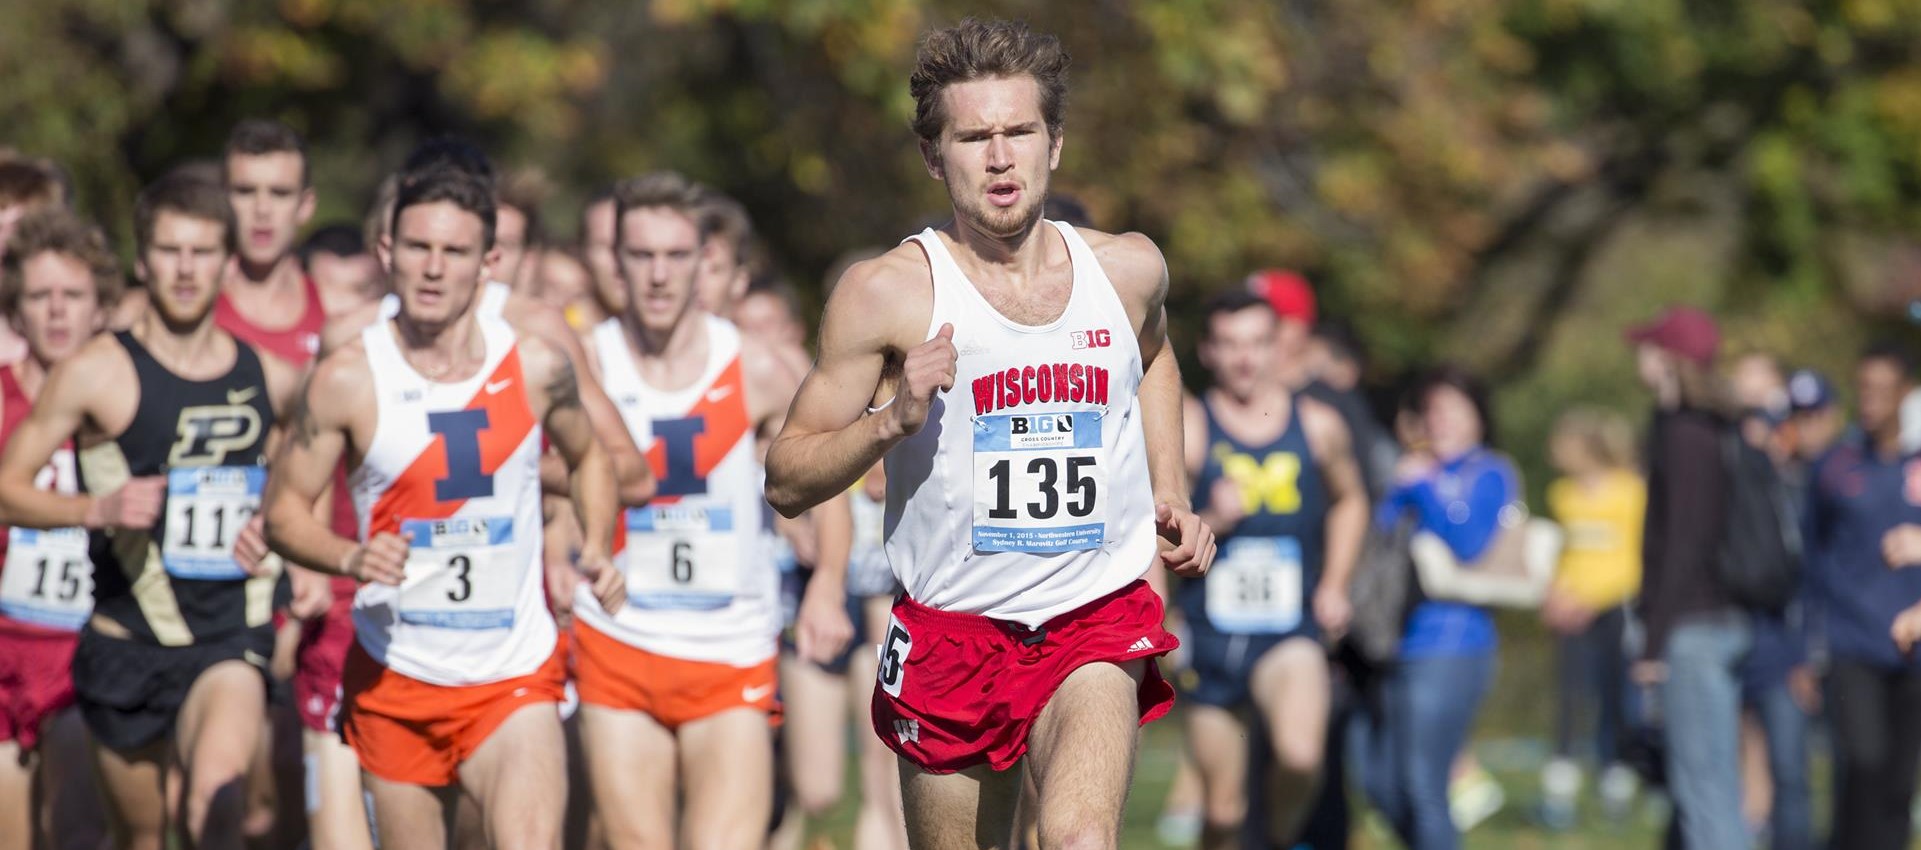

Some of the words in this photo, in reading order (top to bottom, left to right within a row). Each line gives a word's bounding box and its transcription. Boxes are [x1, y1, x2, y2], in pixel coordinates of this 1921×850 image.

[972, 363, 1109, 416] WISCONSIN
[167, 404, 262, 467] P
[427, 408, 494, 501] I
[652, 416, 707, 496] I
[988, 456, 1097, 520] 135
[992, 539, 1016, 547] Sydney
[1027, 539, 1054, 547] Marovitz
[1055, 538, 1067, 546] Golf
[1038, 531, 1075, 539] Northwestern
[1076, 528, 1102, 537] University
[31, 557, 82, 602] 15
[446, 554, 472, 602] 3
[672, 542, 693, 584] 6
[883, 624, 909, 686] 5
